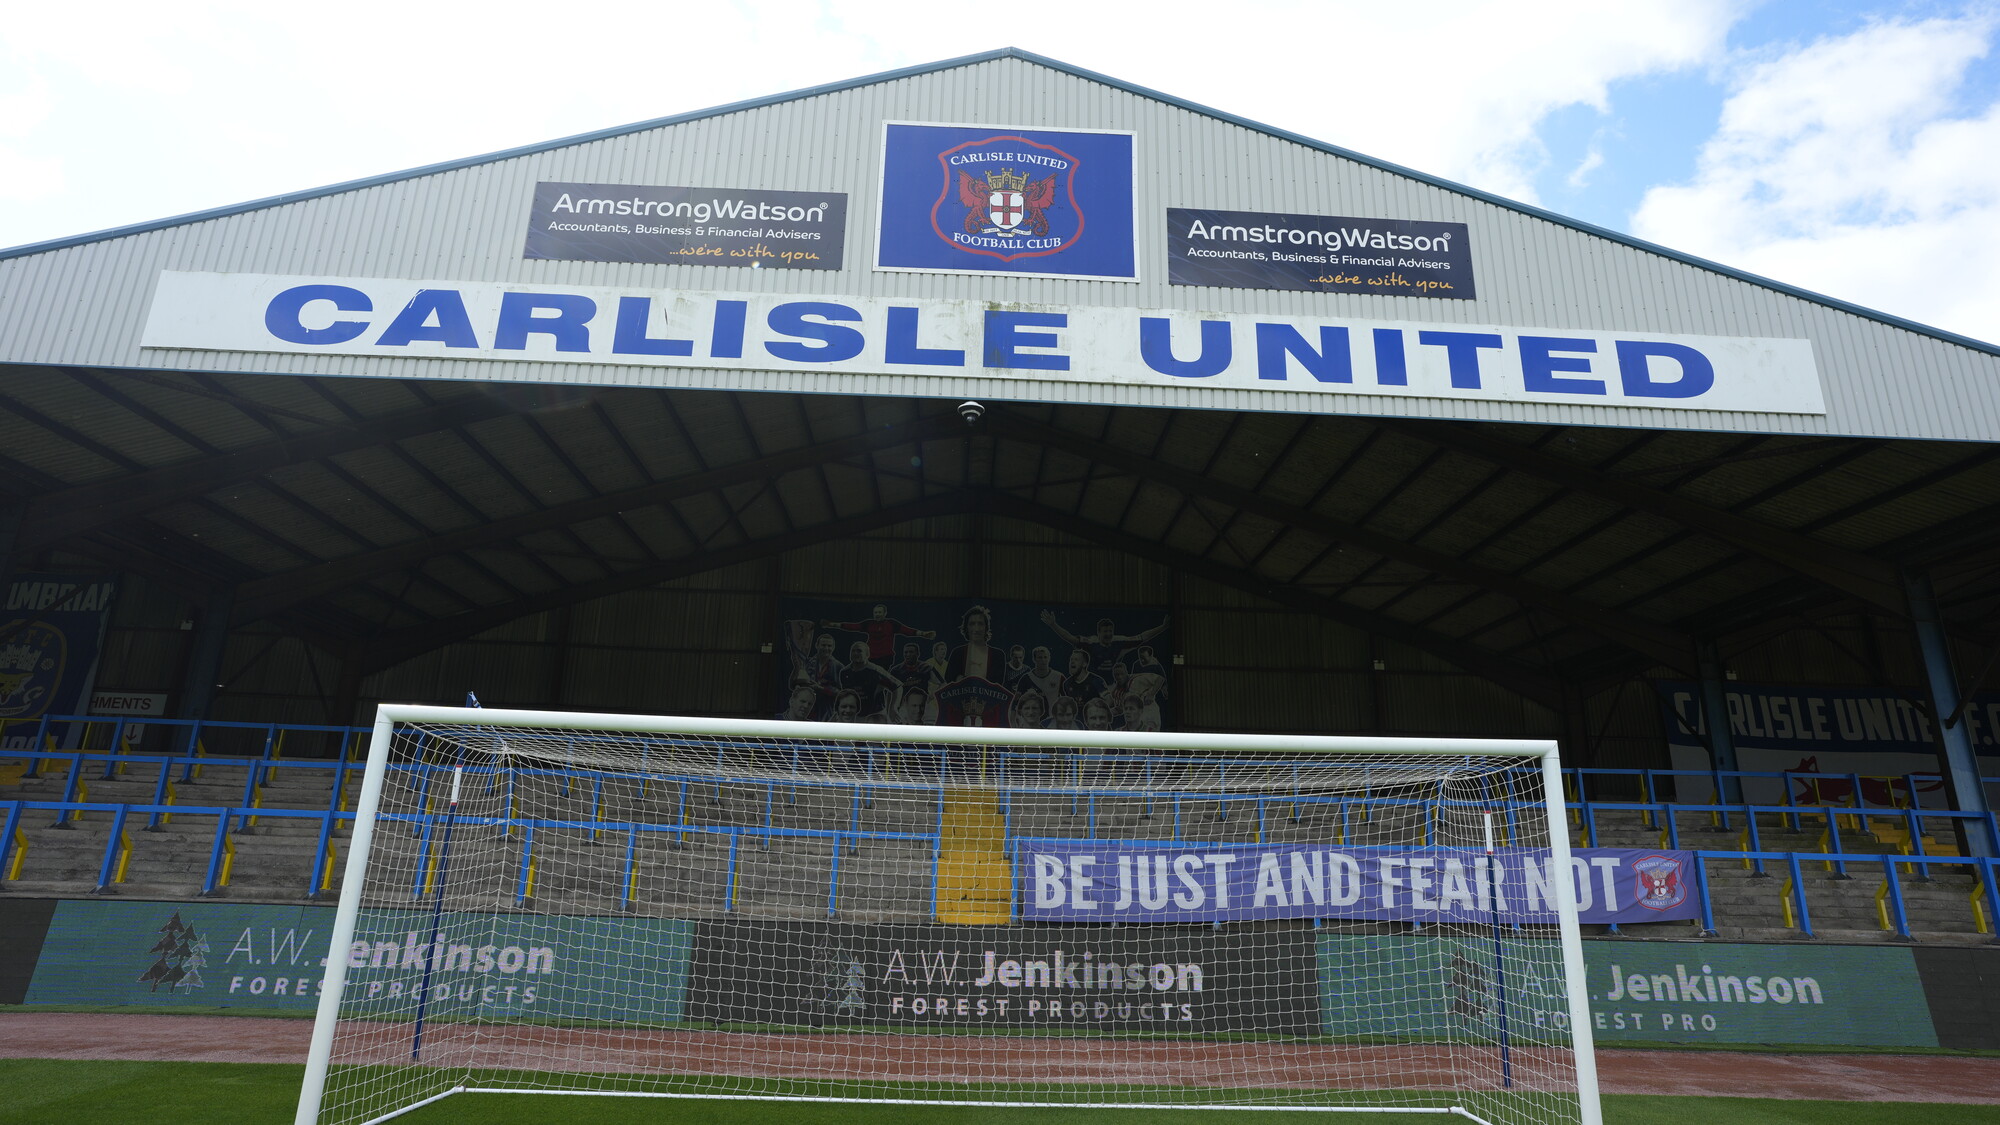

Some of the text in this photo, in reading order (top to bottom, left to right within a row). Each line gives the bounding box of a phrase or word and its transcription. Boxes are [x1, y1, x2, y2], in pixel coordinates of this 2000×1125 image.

[950, 151, 1068, 170] CARLISLE UNITED
[548, 221, 821, 240] Accountants, Business & Financial Advisers
[953, 232, 1024, 249] FOOTBALL
[1026, 236, 1062, 249] CLUB
[730, 243, 775, 258] with
[780, 251, 820, 264] you
[1187, 247, 1451, 270] Accountants, Business & Financial Advisers
[1367, 272, 1411, 287] with
[1416, 280, 1454, 293] you
[264, 284, 1715, 399] CARLISLE UNITED
[940, 686, 1008, 701] CARLISLE UNITED
[1833, 698, 1937, 743] UNITE
[1034, 854, 1098, 910] BE
[1114, 854, 1236, 911] JUST
[1254, 851, 1361, 907] AND
[1380, 857, 1509, 912] FEAR
[225, 927, 554, 974] A.W. enkinson
[883, 949, 1203, 991] A.W. Jenkinson
[1608, 964, 1824, 1004] Jenkinson
[892, 997, 1193, 1021] FOREST PRODUCTS
[1534, 1010, 1717, 1031] FOEST PRO
